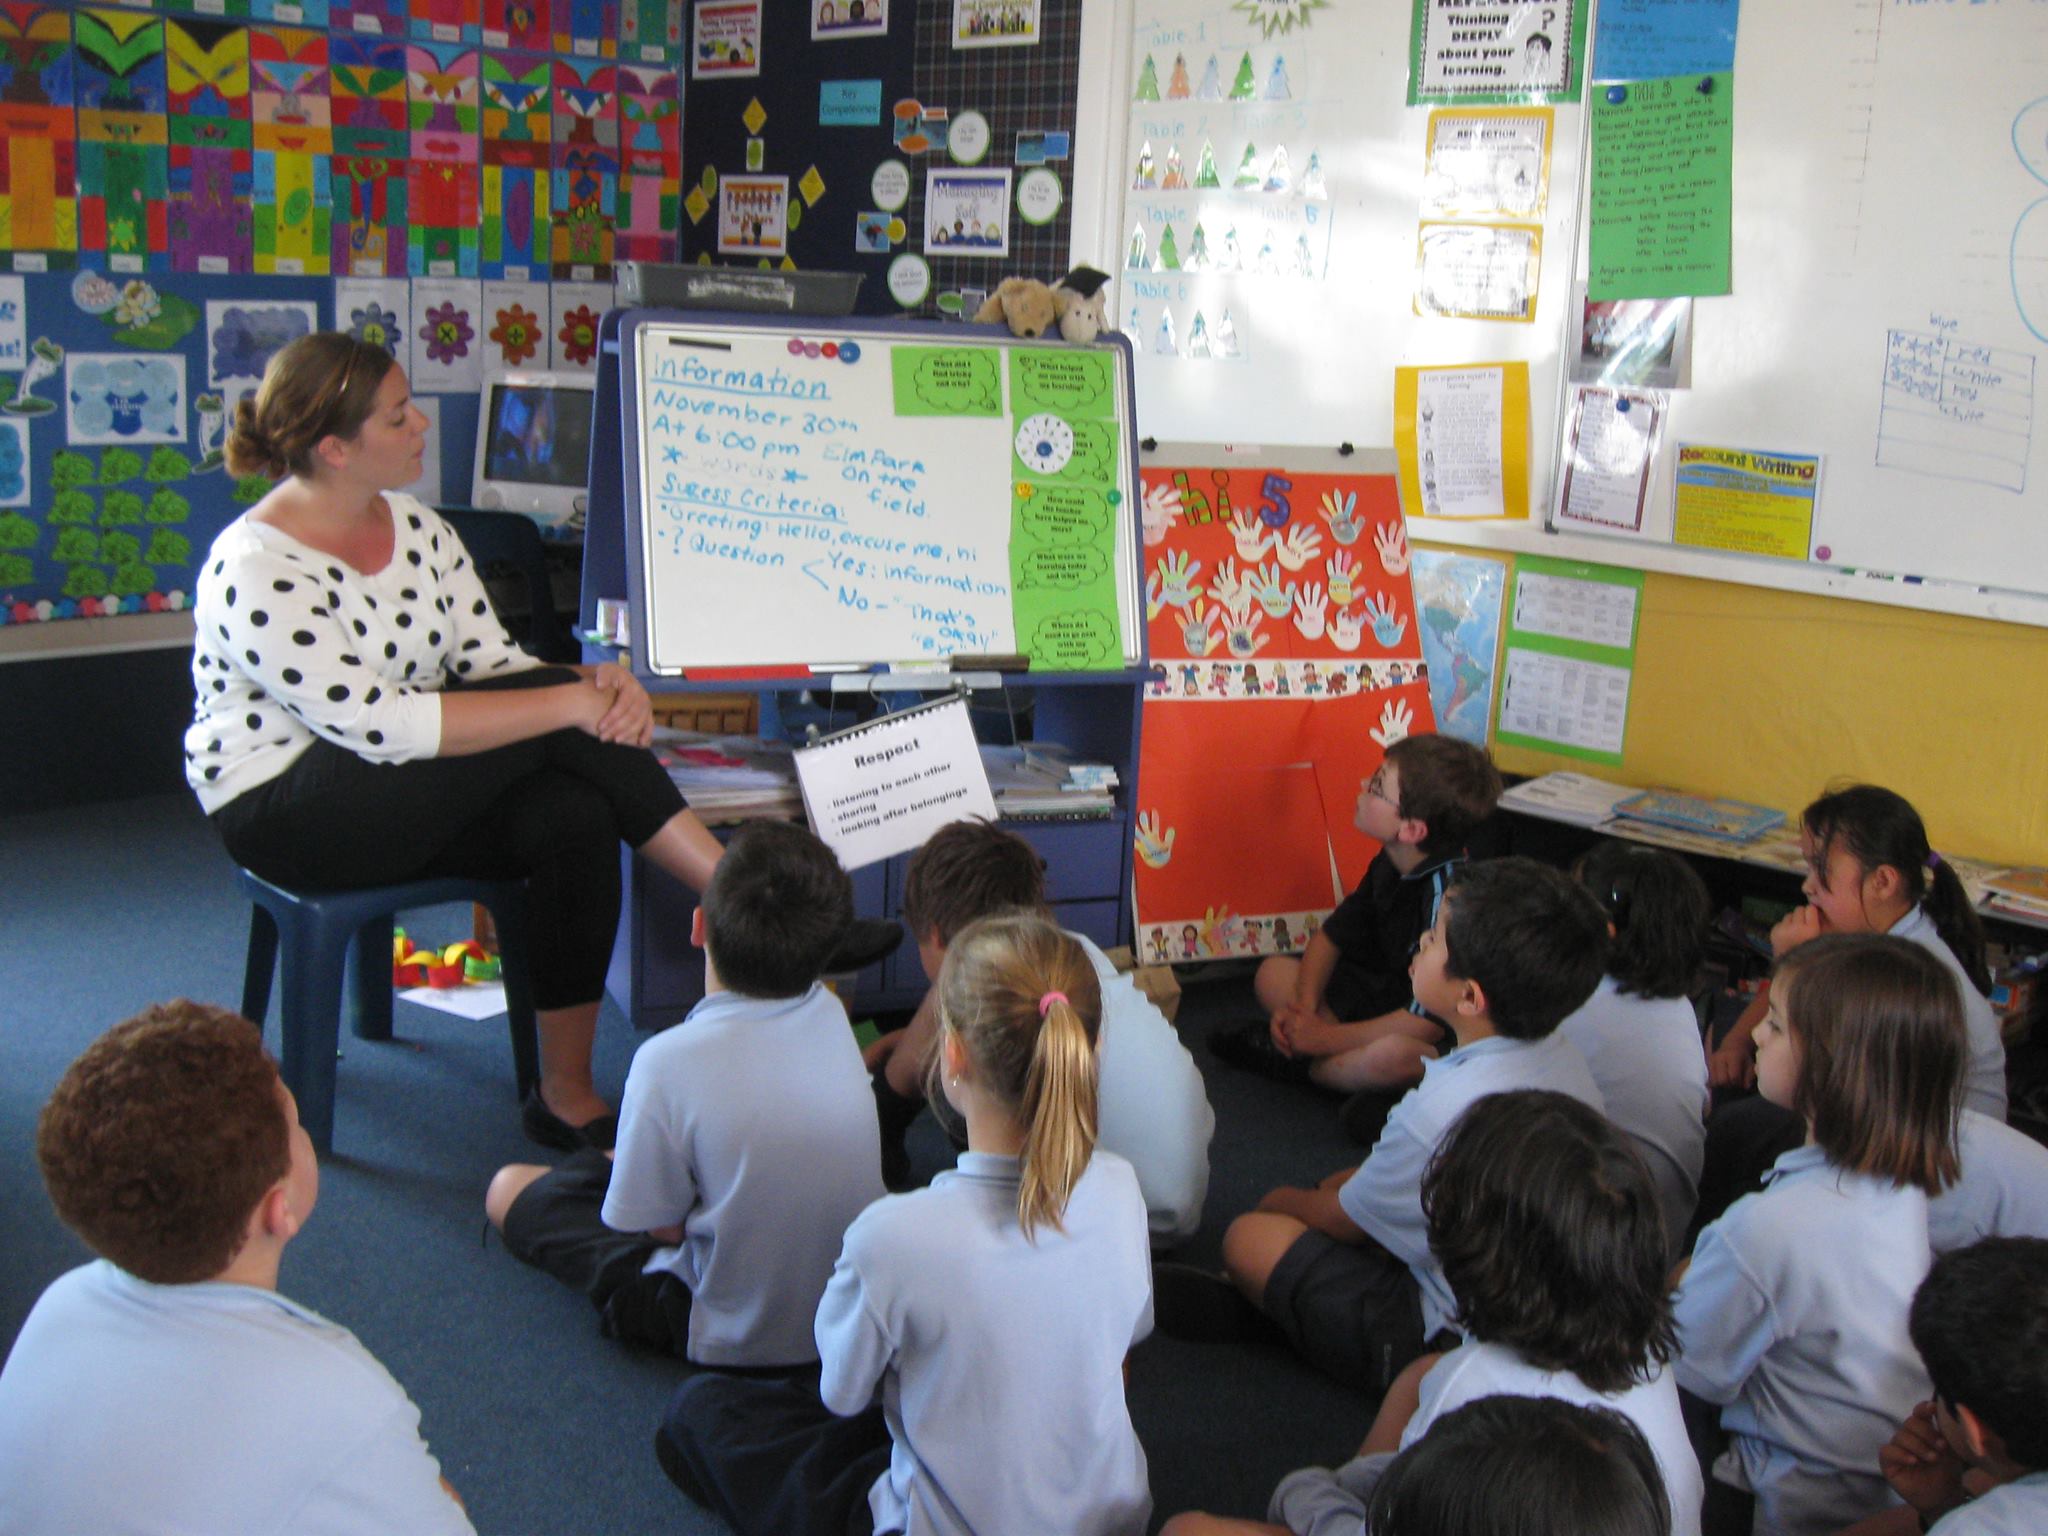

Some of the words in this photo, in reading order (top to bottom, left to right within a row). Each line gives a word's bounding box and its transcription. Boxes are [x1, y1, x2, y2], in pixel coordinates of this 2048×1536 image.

[1448, 14, 1509, 26] Thinking
[1452, 30, 1502, 42] DEEPLY
[1437, 50, 1477, 60] about
[1482, 49, 1515, 62] your
[1443, 65, 1506, 77] learning.
[937, 182, 999, 204] Managing
[955, 204, 979, 220] Self
[1930, 312, 1958, 331] blue
[1958, 347, 1991, 366] red
[653, 389, 792, 427] November
[695, 424, 756, 450] 6:00
[763, 440, 800, 459] pm
[1679, 447, 1747, 467] Recount
[1751, 456, 1815, 480] Writing
[1172, 469, 1232, 526] hi
[1259, 473, 1292, 529] 5
[690, 532, 785, 567] Question
[839, 531, 906, 552] excuse
[884, 563, 1007, 598] information
[838, 584, 869, 611] No
[853, 737, 920, 769] Respect
[831, 786, 880, 811] listening
[880, 779, 893, 792] to
[894, 771, 922, 788] each
[923, 761, 952, 779] other
[836, 802, 878, 823] sharing
[840, 816, 882, 837] looking
[882, 806, 909, 823] after
[909, 786, 969, 813] belongings
